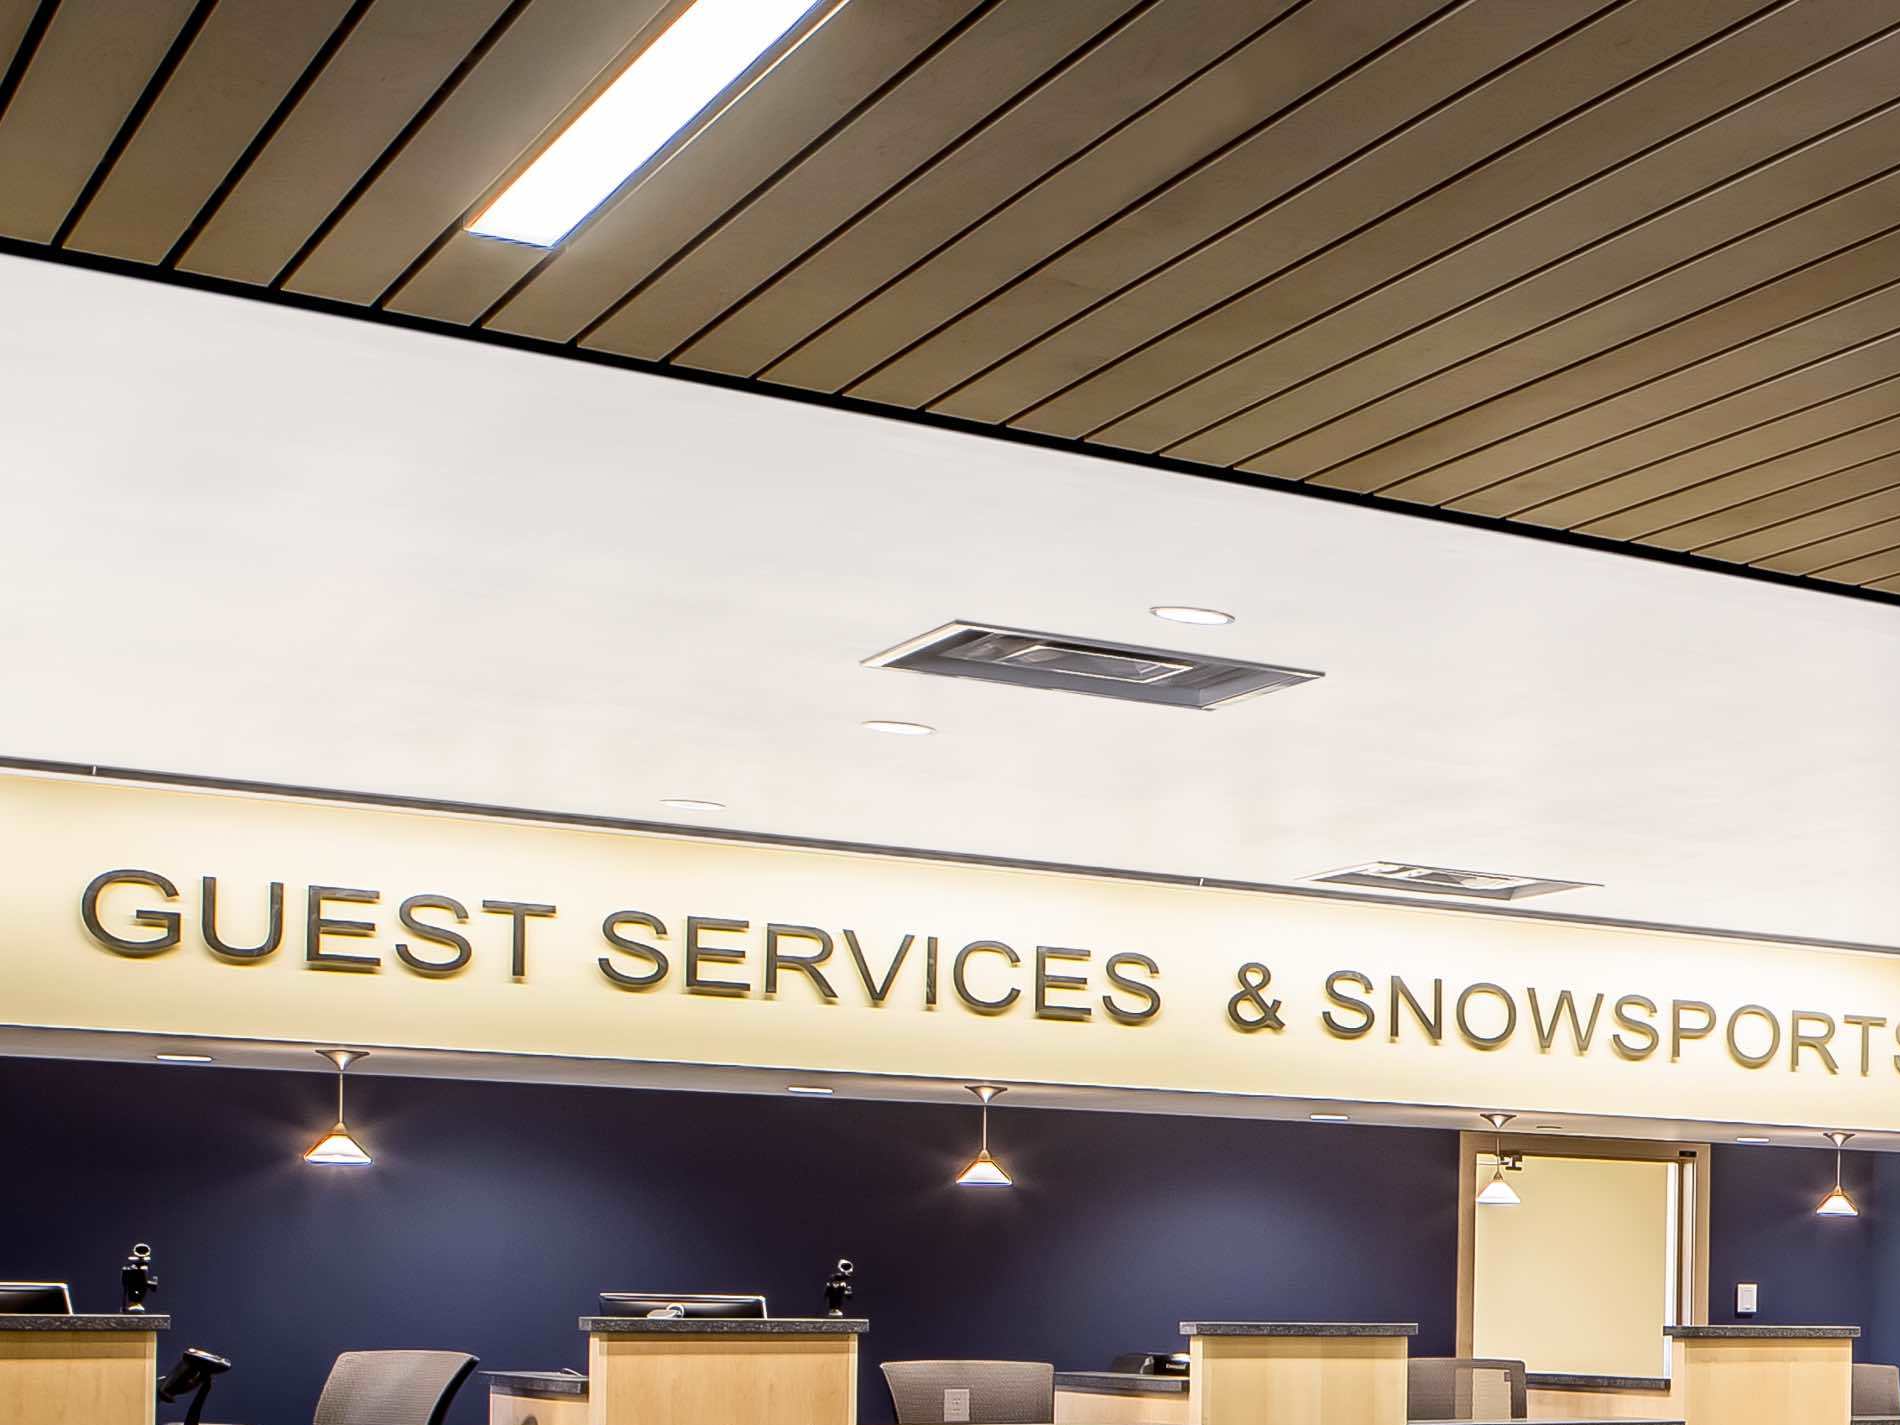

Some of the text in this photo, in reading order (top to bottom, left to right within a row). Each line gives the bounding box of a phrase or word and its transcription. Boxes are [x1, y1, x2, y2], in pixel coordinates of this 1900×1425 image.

[79, 868, 557, 983] GUEST
[597, 908, 1161, 1026] SERVICES
[1226, 960, 1288, 1032] &
